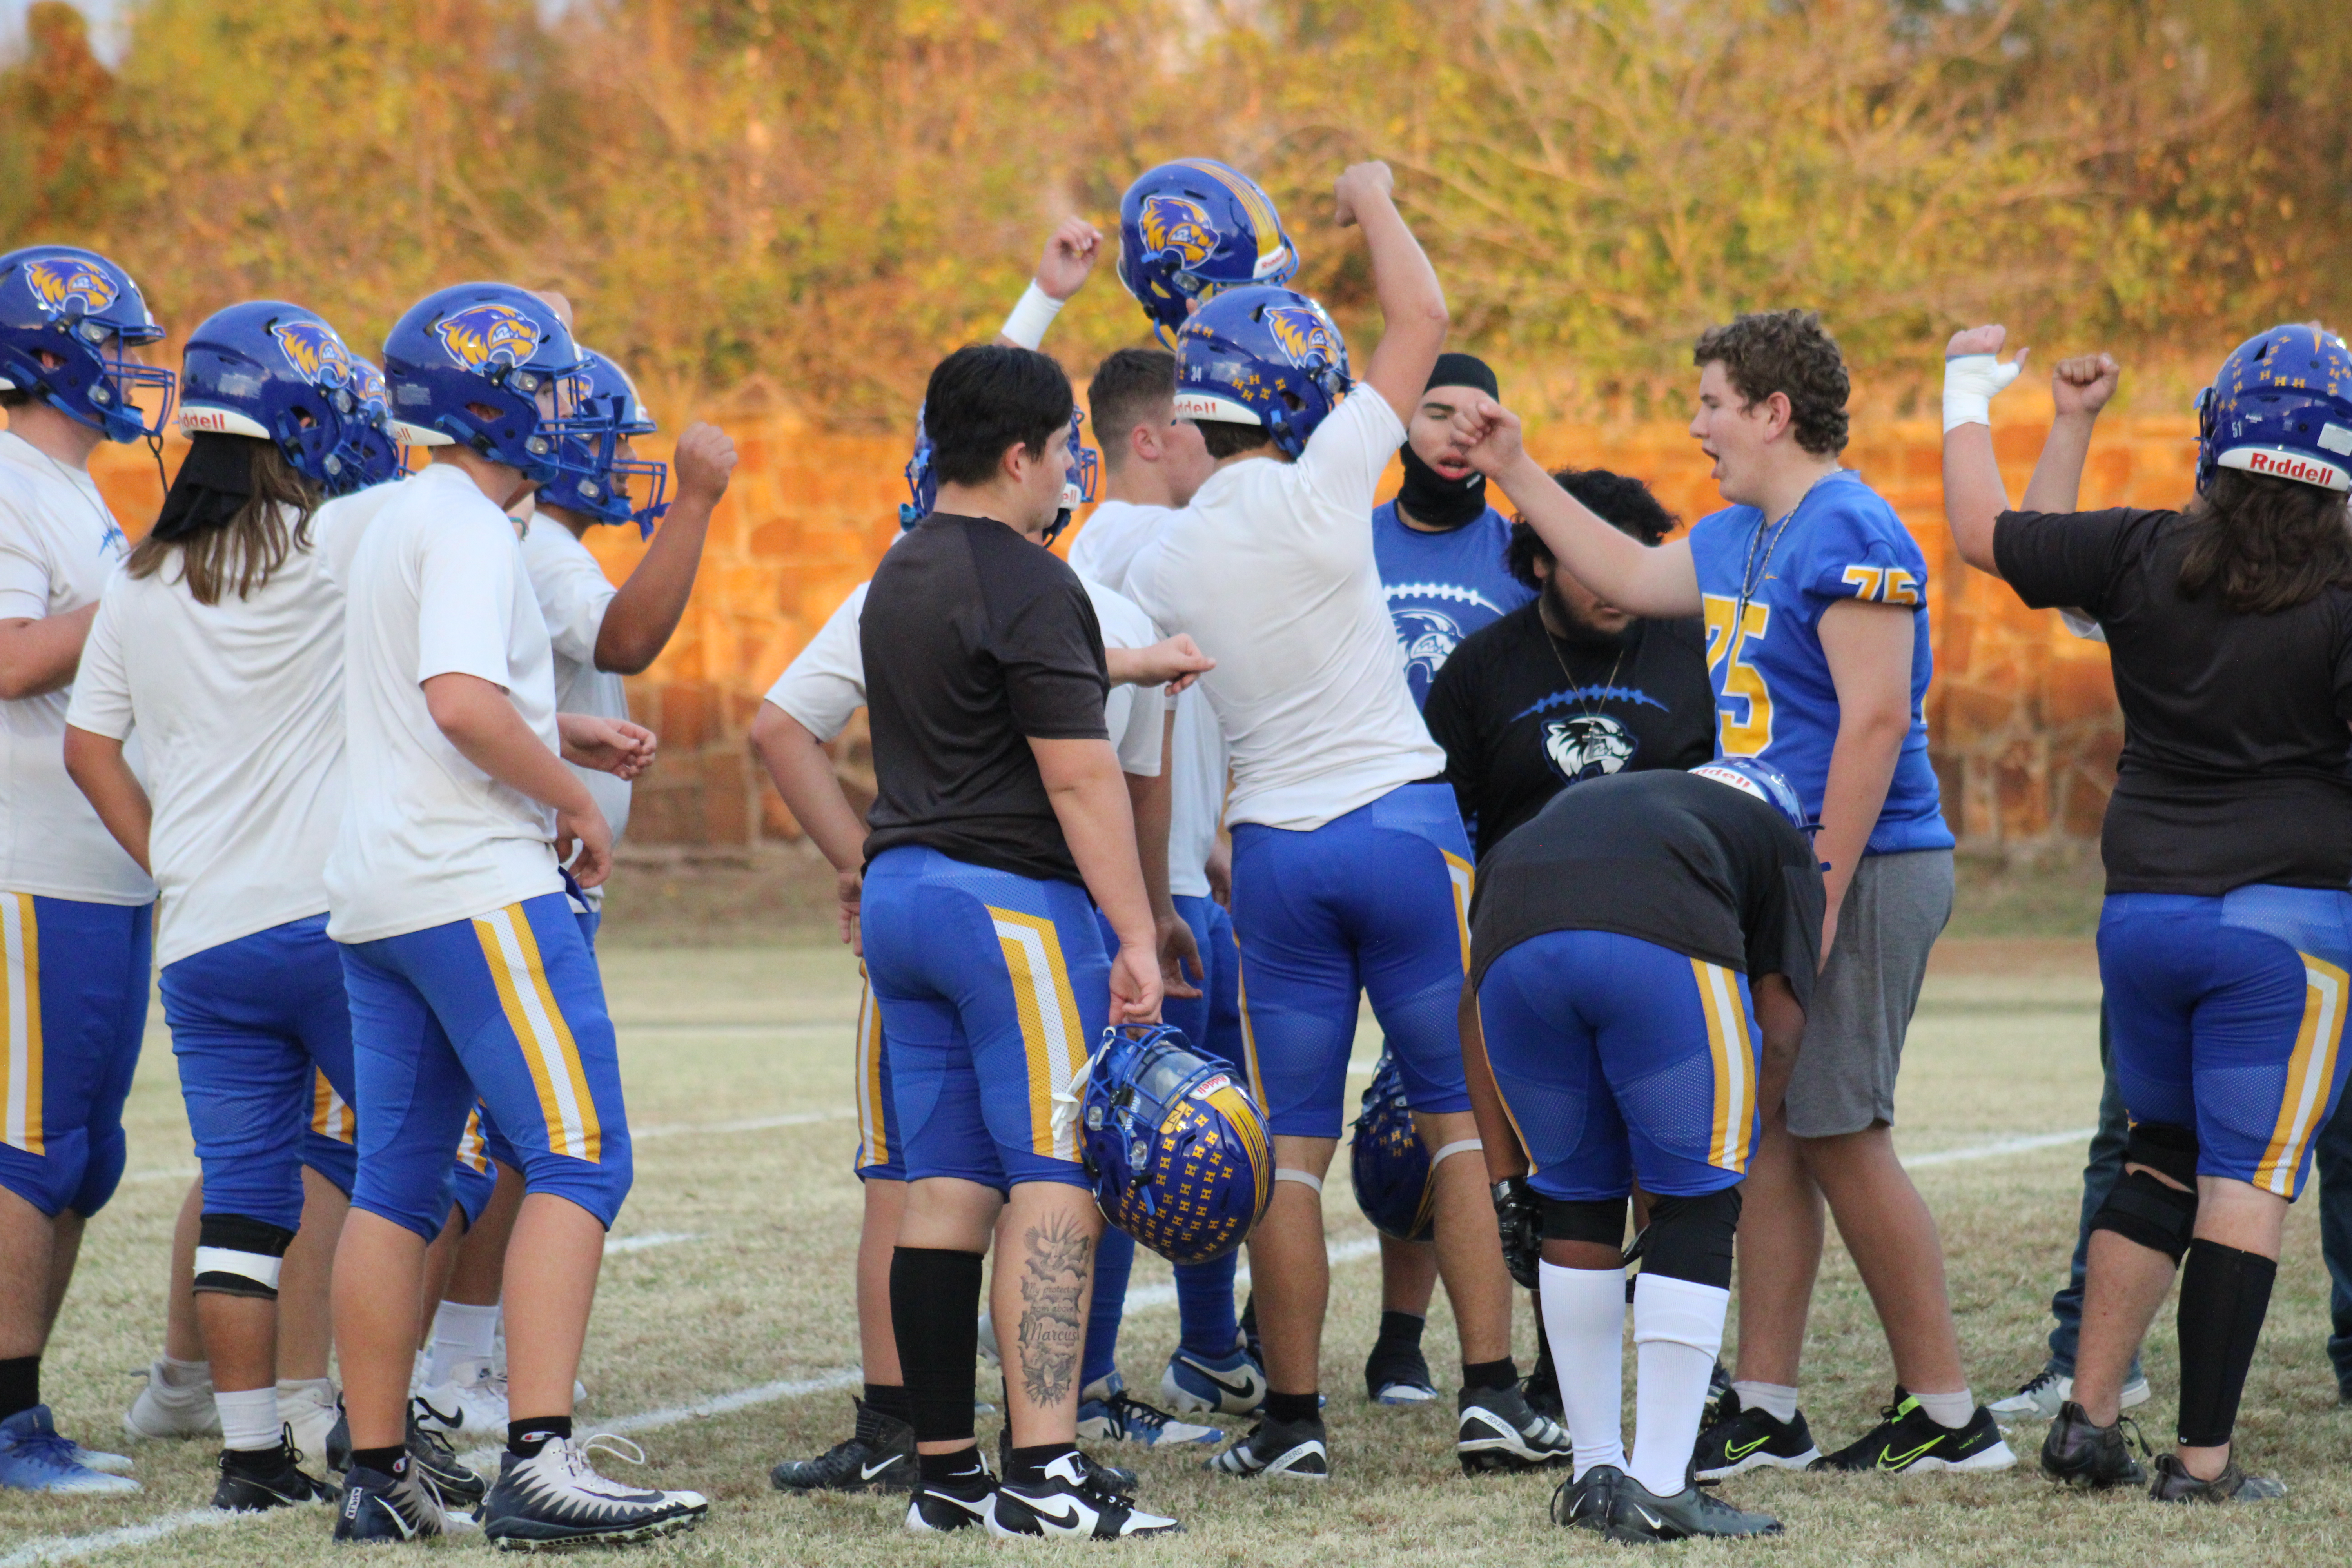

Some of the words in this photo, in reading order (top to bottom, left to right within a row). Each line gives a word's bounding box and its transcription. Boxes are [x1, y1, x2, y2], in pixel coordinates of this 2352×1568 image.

[1203, 327, 1214, 338] H
[1191, 366, 1201, 382] 34
[1249, 375, 1260, 385] H
[2260, 370, 2270, 381] H
[1232, 377, 1245, 390] H
[1275, 378, 1286, 391] H
[2234, 381, 2243, 394] H
[2274, 376, 2287, 387] H
[2294, 378, 2305, 388] H
[1241, 389, 1254, 402] H
[1260, 388, 1271, 400] H
[2232, 420, 2242, 438] 51
[2250, 452, 2333, 485] Riddell
[1841, 564, 1918, 605] 75
[1702, 592, 1773, 759] 75
[1198, 1075, 1227, 1094] Riddell
[1194, 1114, 1209, 1128] H
[1205, 1130, 1219, 1145] H
[1391, 1130, 1401, 1142] H
[1162, 1137, 1176, 1152] H
[1403, 1138, 1414, 1148] H
[1192, 1145, 1206, 1159] H
[1160, 1156, 1171, 1169] H
[1209, 1152, 1223, 1166] H
[1185, 1163, 1197, 1177] H
[1221, 1166, 1233, 1179] H
[1156, 1173, 1167, 1186] H
[1203, 1171, 1216, 1183] H
[1127, 1187, 1135, 1200] H
[1180, 1183, 1192, 1196] H
[1200, 1188, 1212, 1200] H
[1121, 1198, 1129, 1210] H
[1163, 1193, 1173, 1205] H
[1138, 1200, 1147, 1212] H
[1179, 1200, 1191, 1212] H
[1196, 1206, 1207, 1216] H
[1132, 1212, 1140, 1223] H
[1156, 1207, 1167, 1219] H
[1146, 1218, 1156, 1229] H
[1172, 1216, 1183, 1226] H
[1190, 1221, 1201, 1230] H
[1208, 1220, 1219, 1229] H
[1226, 1217, 1237, 1227] H
[1163, 1227, 1174, 1236] H
[1181, 1232, 1192, 1241] H
[1024, 1321, 1077, 1341] Marcus
[1485, 1415, 1514, 1437] ADIZERO
[1275, 1447, 1303, 1469] ADIZERO
